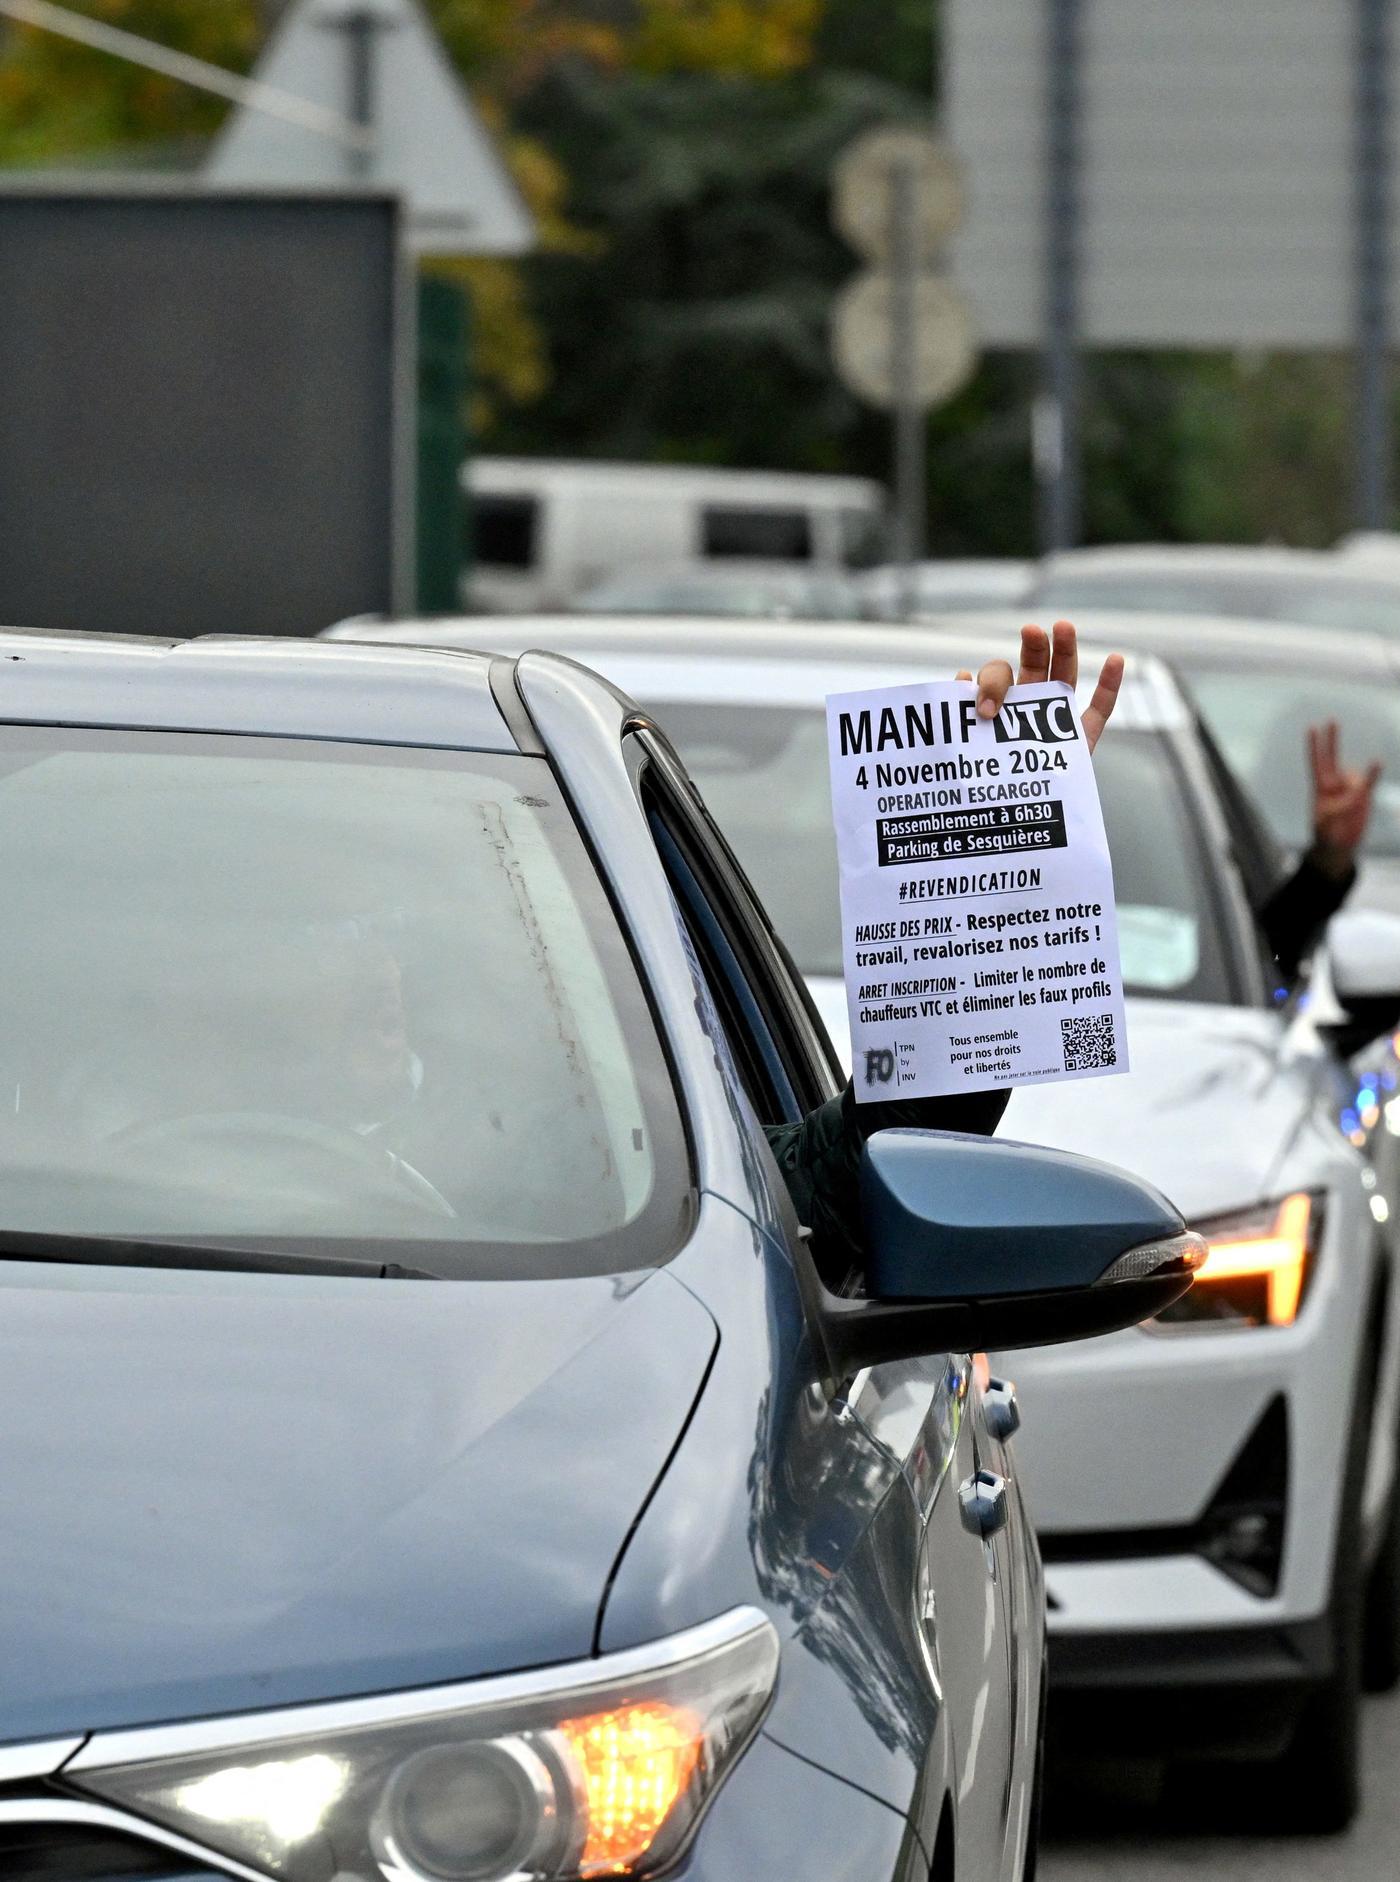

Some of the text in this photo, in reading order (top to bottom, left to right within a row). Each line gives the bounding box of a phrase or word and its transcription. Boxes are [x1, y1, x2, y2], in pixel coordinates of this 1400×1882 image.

[839, 700, 1075, 756] MANIF VTC
[856, 749, 1067, 789] 4 Novembre 2024
[877, 780, 1051, 813] OPERATION ESCARGOT
[882, 804, 1052, 836] Rassemblement à 6h30
[888, 829, 1050, 858] Parking de Sesquières
[899, 868, 1042, 900] #REVENDICATION
[855, 922, 896, 942] HAUSSE
[900, 919, 921, 938] DES
[924, 916, 952, 935] PRIX
[967, 909, 1050, 932] Respectez
[1056, 904, 1101, 921] notre
[856, 926, 1101, 967] travail, revalorisez nos tarifs !
[859, 982, 887, 1000] ARRET
[891, 977, 956, 996] INSCRIPTION
[974, 969, 1018, 988] Limiter
[1023, 966, 1034, 981] le
[1038, 961, 1087, 980] nombre
[1091, 958, 1106, 973] de
[860, 981, 1111, 1024] chauffeurs VTC et éliminer les faux profils
[899, 1044, 915, 1052] TPN
[949, 1030, 1018, 1046] Tous ensemble
[950, 1044, 1021, 1064] pour nos droits
[901, 1059, 909, 1067] by
[964, 1060, 1011, 1074] et libertés
